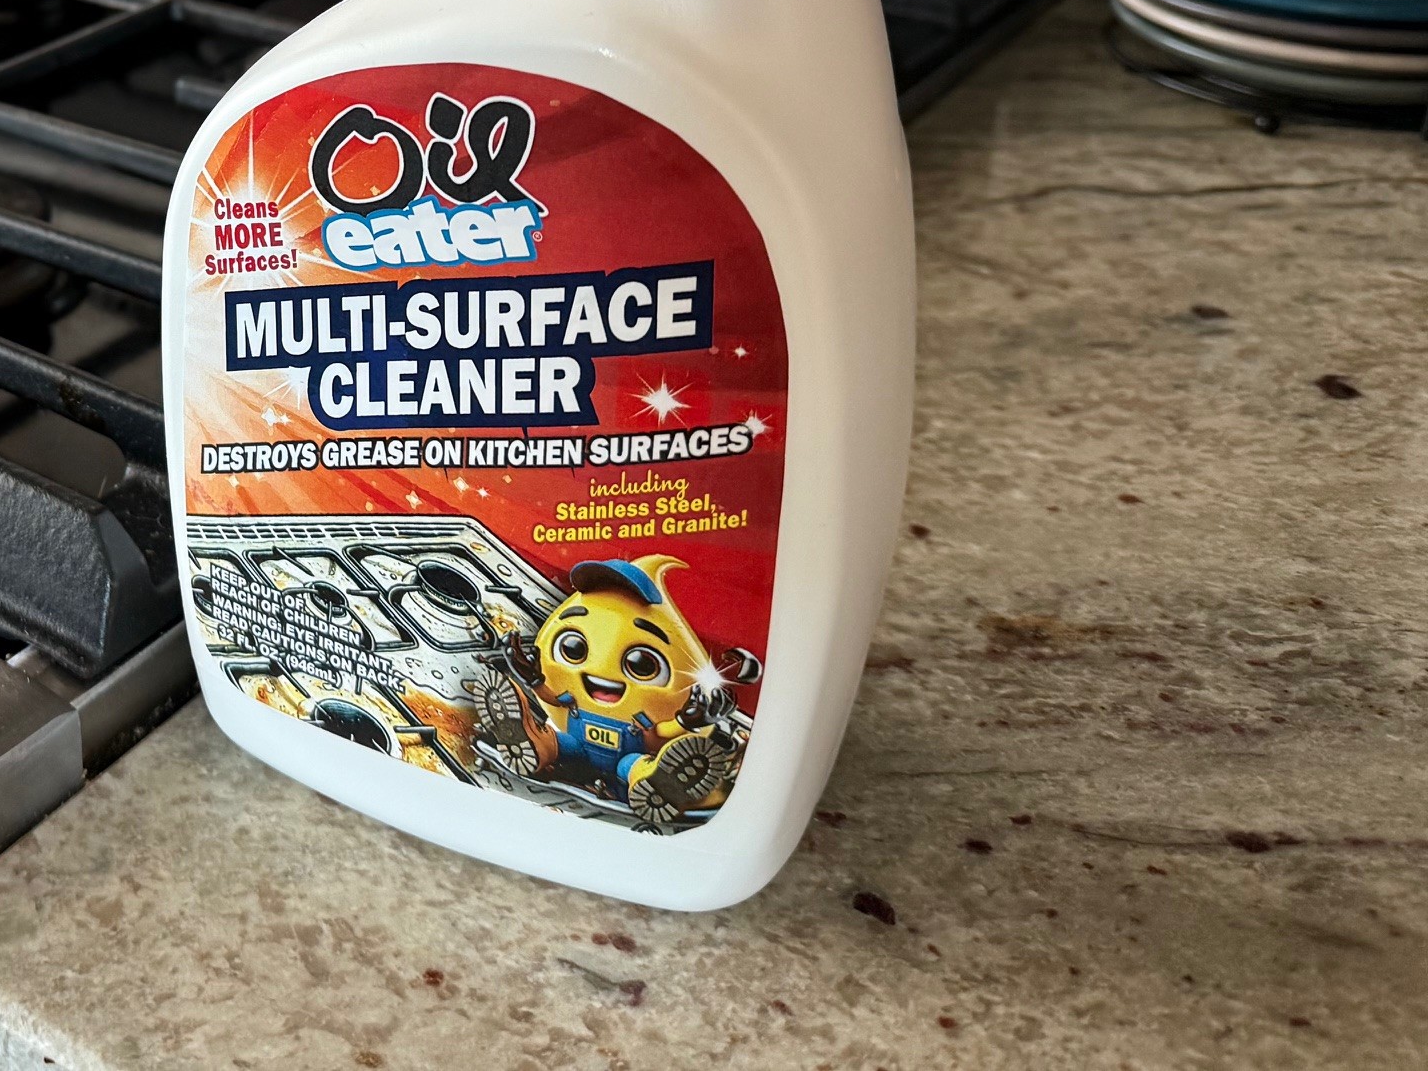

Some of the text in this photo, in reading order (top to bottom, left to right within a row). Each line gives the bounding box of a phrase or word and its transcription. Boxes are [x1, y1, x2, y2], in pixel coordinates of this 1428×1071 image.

[310, 93, 548, 217] Oil
[214, 198, 279, 220] Cleans
[214, 222, 284, 251] MORE
[204, 248, 298, 275] Surfaces!
[235, 276, 698, 358] MULTI-SURFACE
[319, 357, 582, 418] CLEANER
[203, 425, 750, 472] DESTROYS GREASE ON KITCHEN SURFACES
[589, 469, 689, 501] including
[533, 509, 747, 543] Ceramic and Granite!
[556, 493, 716, 521] Stainless Steel,
[210, 564, 305, 610] KEEP OUT OF
[211, 580, 361, 646] REACH OF CHILDREN
[212, 592, 282, 631] WARNING:
[285, 621, 314, 643] EYE
[212, 605, 405, 693] READ CAUTIONS ON BACK.
[218, 625, 235, 642] 32
[259, 644, 283, 662] OZ.
[588, 727, 615, 746] OIL
